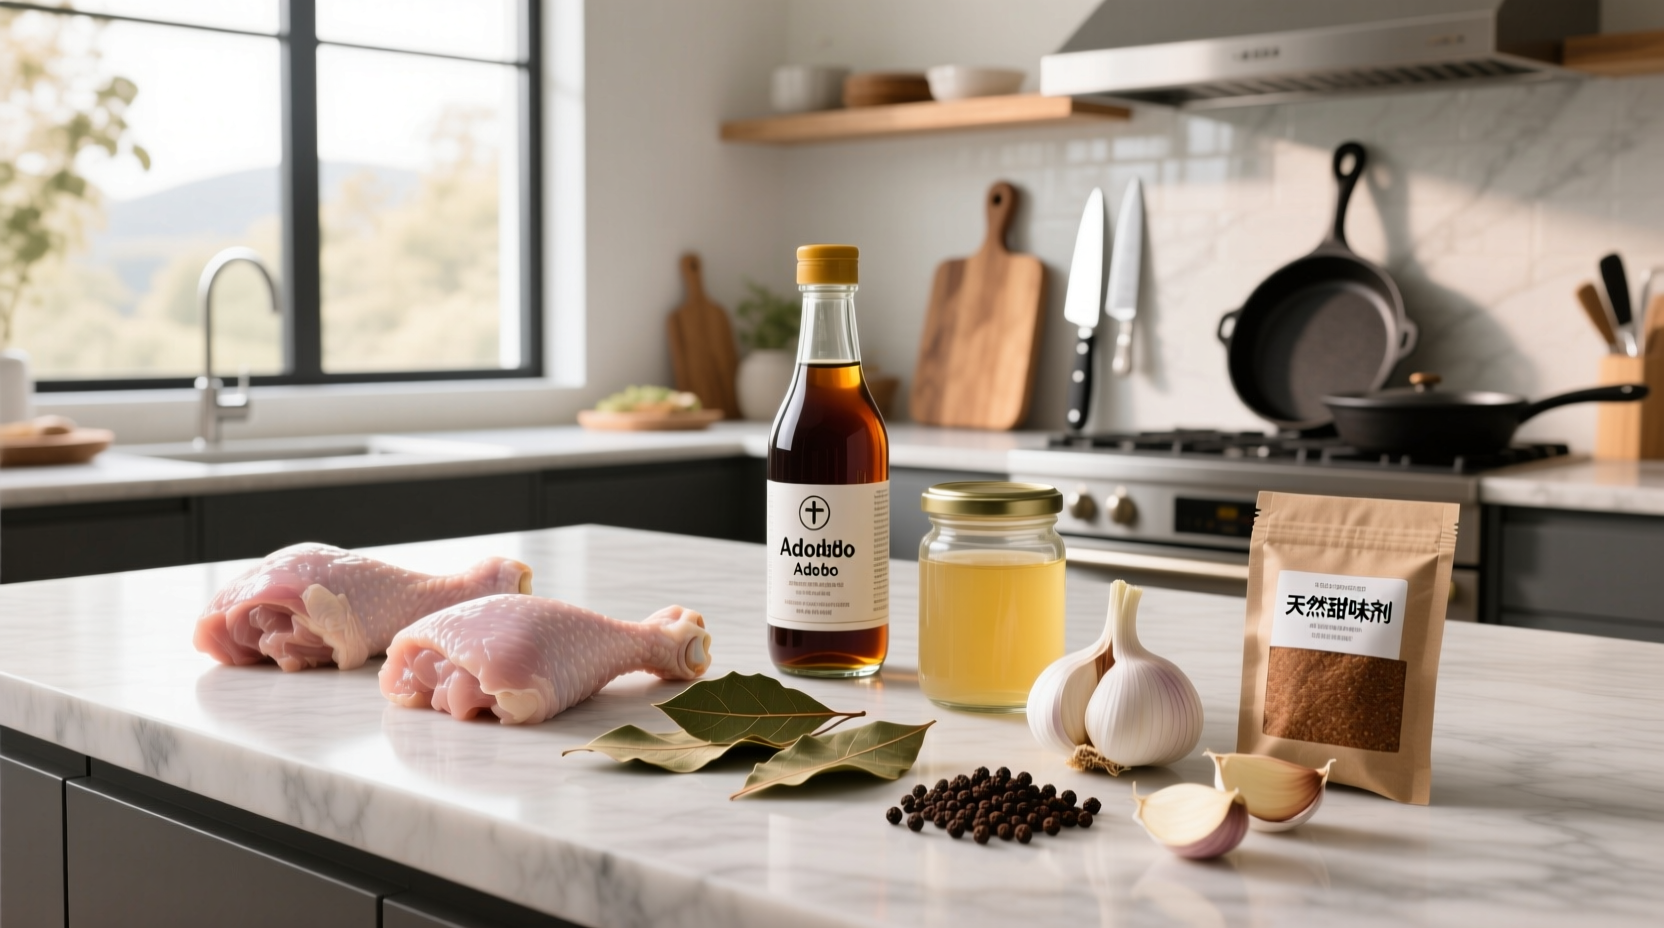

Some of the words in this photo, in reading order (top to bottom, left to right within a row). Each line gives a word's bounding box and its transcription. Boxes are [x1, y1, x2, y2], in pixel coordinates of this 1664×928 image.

[793, 561, 839, 577] Adobo
[1285, 594, 1393, 625] 天然甜味剂
